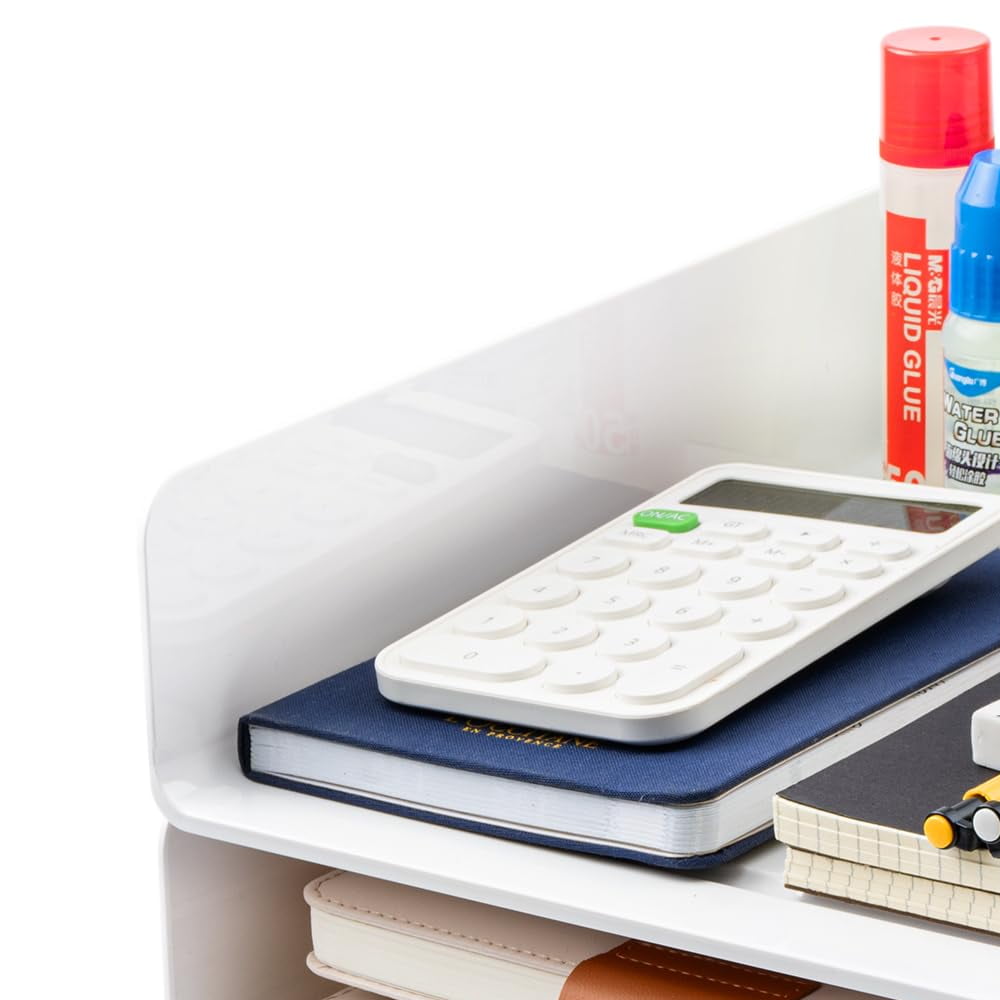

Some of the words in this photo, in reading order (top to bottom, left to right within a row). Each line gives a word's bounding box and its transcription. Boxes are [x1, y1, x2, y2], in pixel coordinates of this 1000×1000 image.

[903, 252, 922, 342] LIQUID
[903, 349, 922, 423] GLUE
[640, 511, 690, 521] ON/AC
